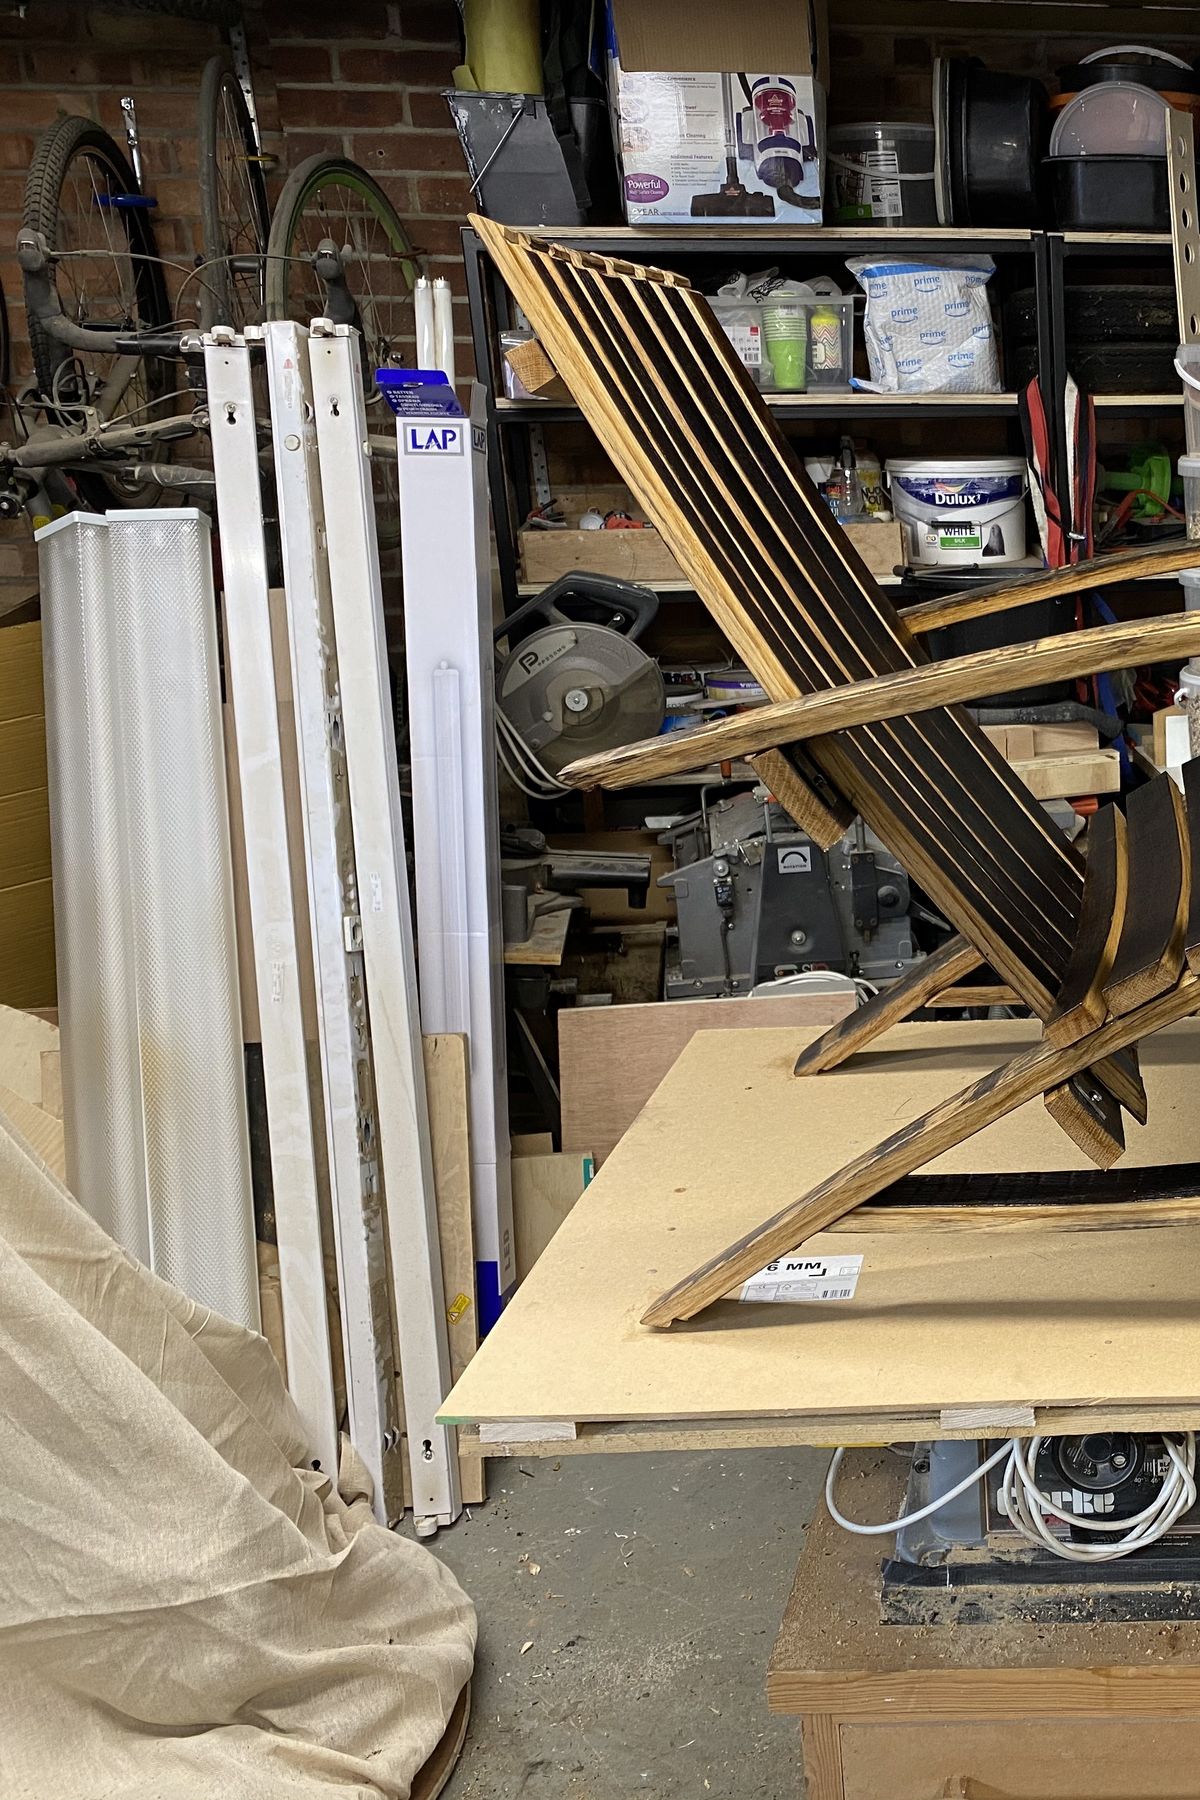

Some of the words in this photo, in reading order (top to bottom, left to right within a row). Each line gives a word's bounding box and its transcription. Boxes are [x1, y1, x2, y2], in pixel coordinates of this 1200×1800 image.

[627, 179, 661, 190] Powerful
[637, 208, 660, 216] YEAR
[913, 275, 940, 287] prime
[944, 300, 970, 311] prime
[891, 307, 918, 318] prime
[919, 330, 946, 340] prime
[947, 351, 974, 362] prime
[896, 357, 922, 368] prime
[411, 428, 457, 450] LAP
[473, 427, 485, 449] LAP
[935, 493, 977, 505] Dulux
[944, 527, 976, 536] WHITE
[503, 1230, 511, 1271] LED
[786, 1262, 822, 1271] MM
[996, 1487, 1115, 1516] Crke
